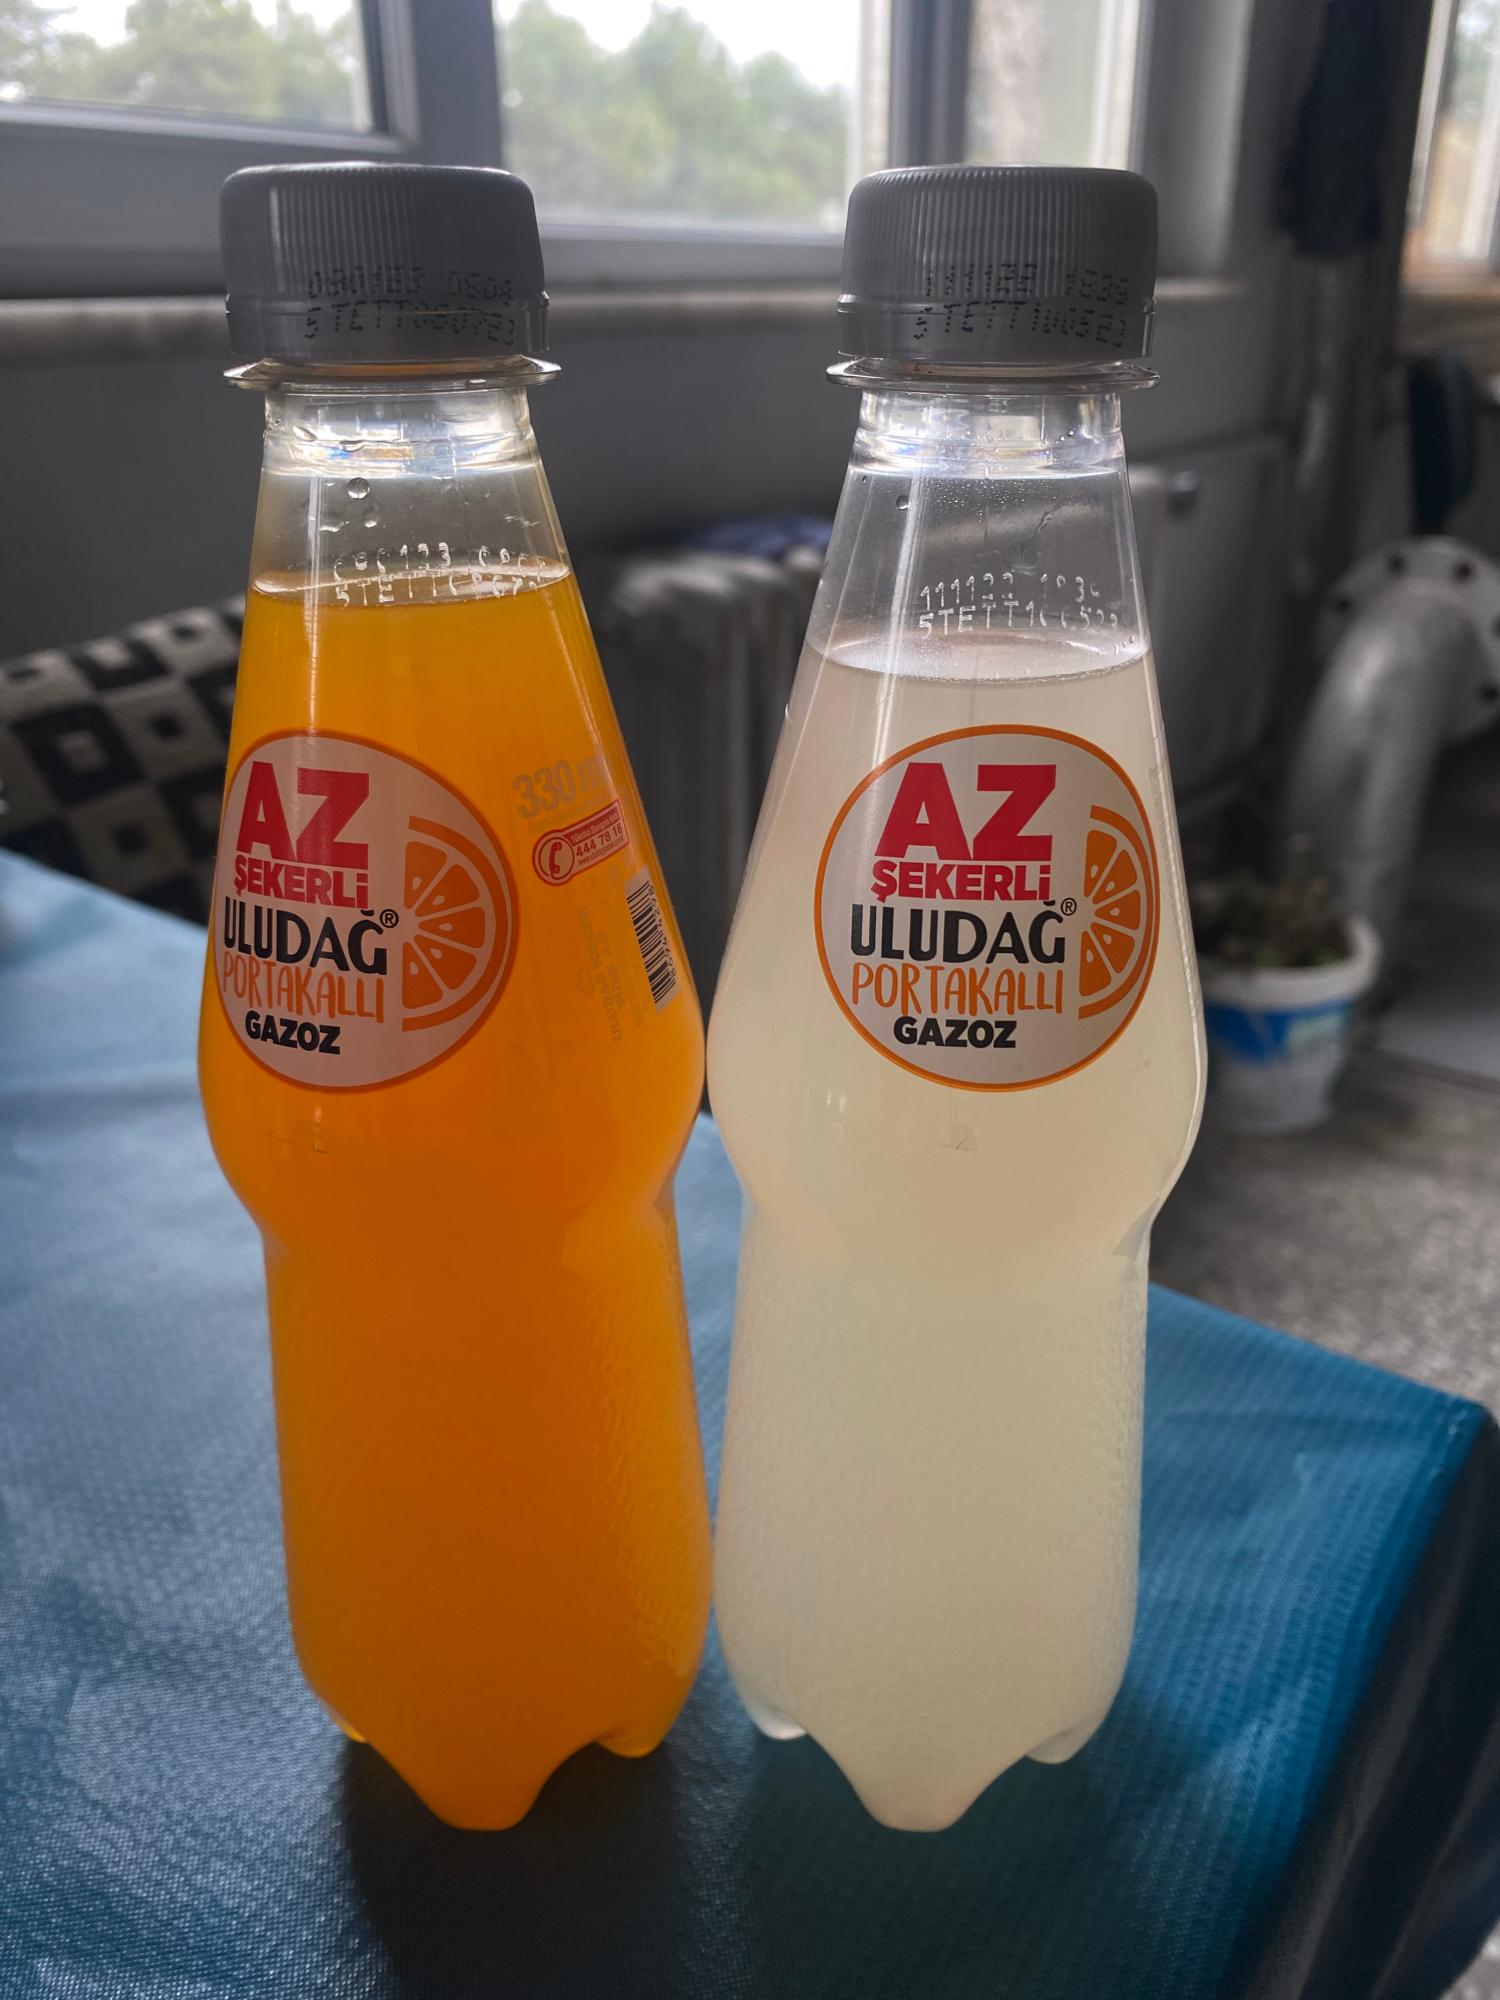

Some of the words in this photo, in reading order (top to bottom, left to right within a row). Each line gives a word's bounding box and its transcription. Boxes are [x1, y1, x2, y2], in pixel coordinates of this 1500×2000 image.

[235, 760, 370, 871] AZ
[511, 759, 577, 819] 330
[874, 761, 1057, 862] AZ
[576, 839, 597, 857] 444
[598, 830, 611, 846] 78
[612, 822, 623, 838] 16
[233, 855, 369, 910] ŞEKERLİ
[870, 859, 1051, 904] ŞEKERLİ
[222, 950, 385, 1024] PORTAKALLI
[851, 961, 1064, 1018] PORTAKALLI
[244, 1010, 341, 1056] GAZOZ
[892, 1015, 1018, 1049] GAZOZ
